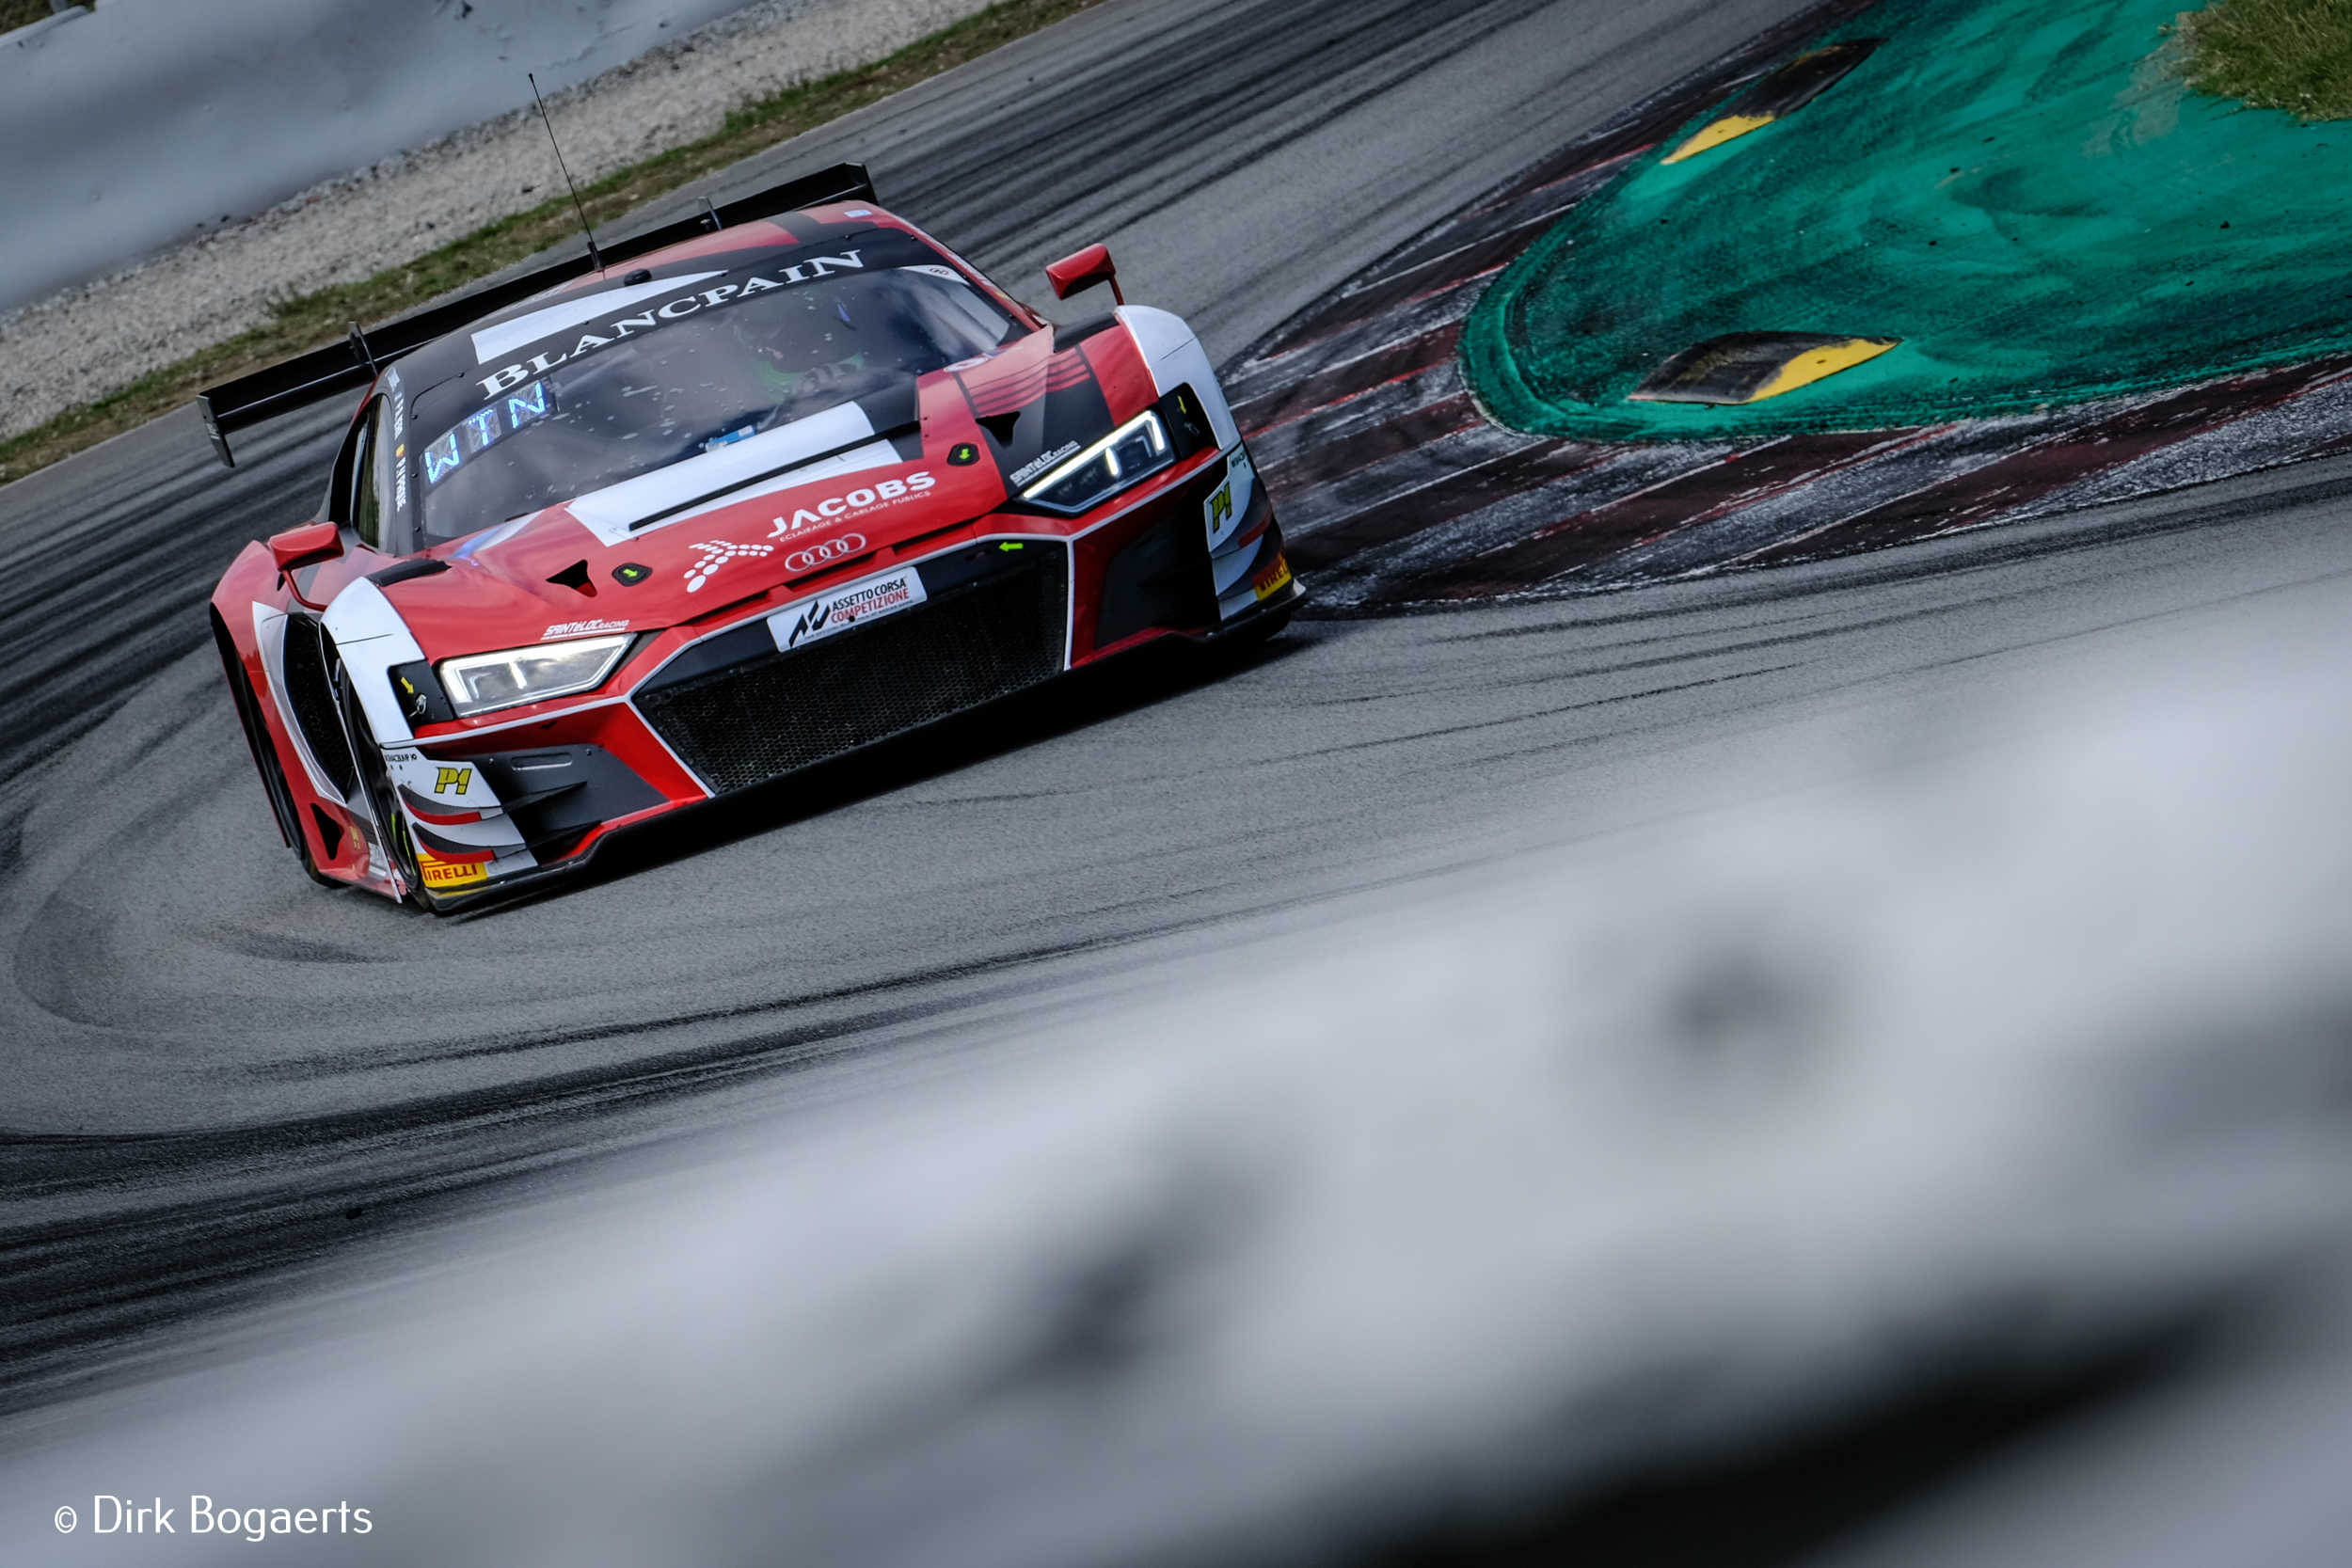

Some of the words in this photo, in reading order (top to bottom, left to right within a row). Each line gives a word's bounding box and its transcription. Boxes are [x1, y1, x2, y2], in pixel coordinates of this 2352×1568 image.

[476, 248, 866, 400] BLANCPAIN
[767, 470, 936, 539] JACOBS
[831, 588, 911, 625] COMPETIZIONE
[832, 590, 875, 612] ASSETTO
[874, 578, 907, 597] CORSA
[434, 767, 472, 795] P1
